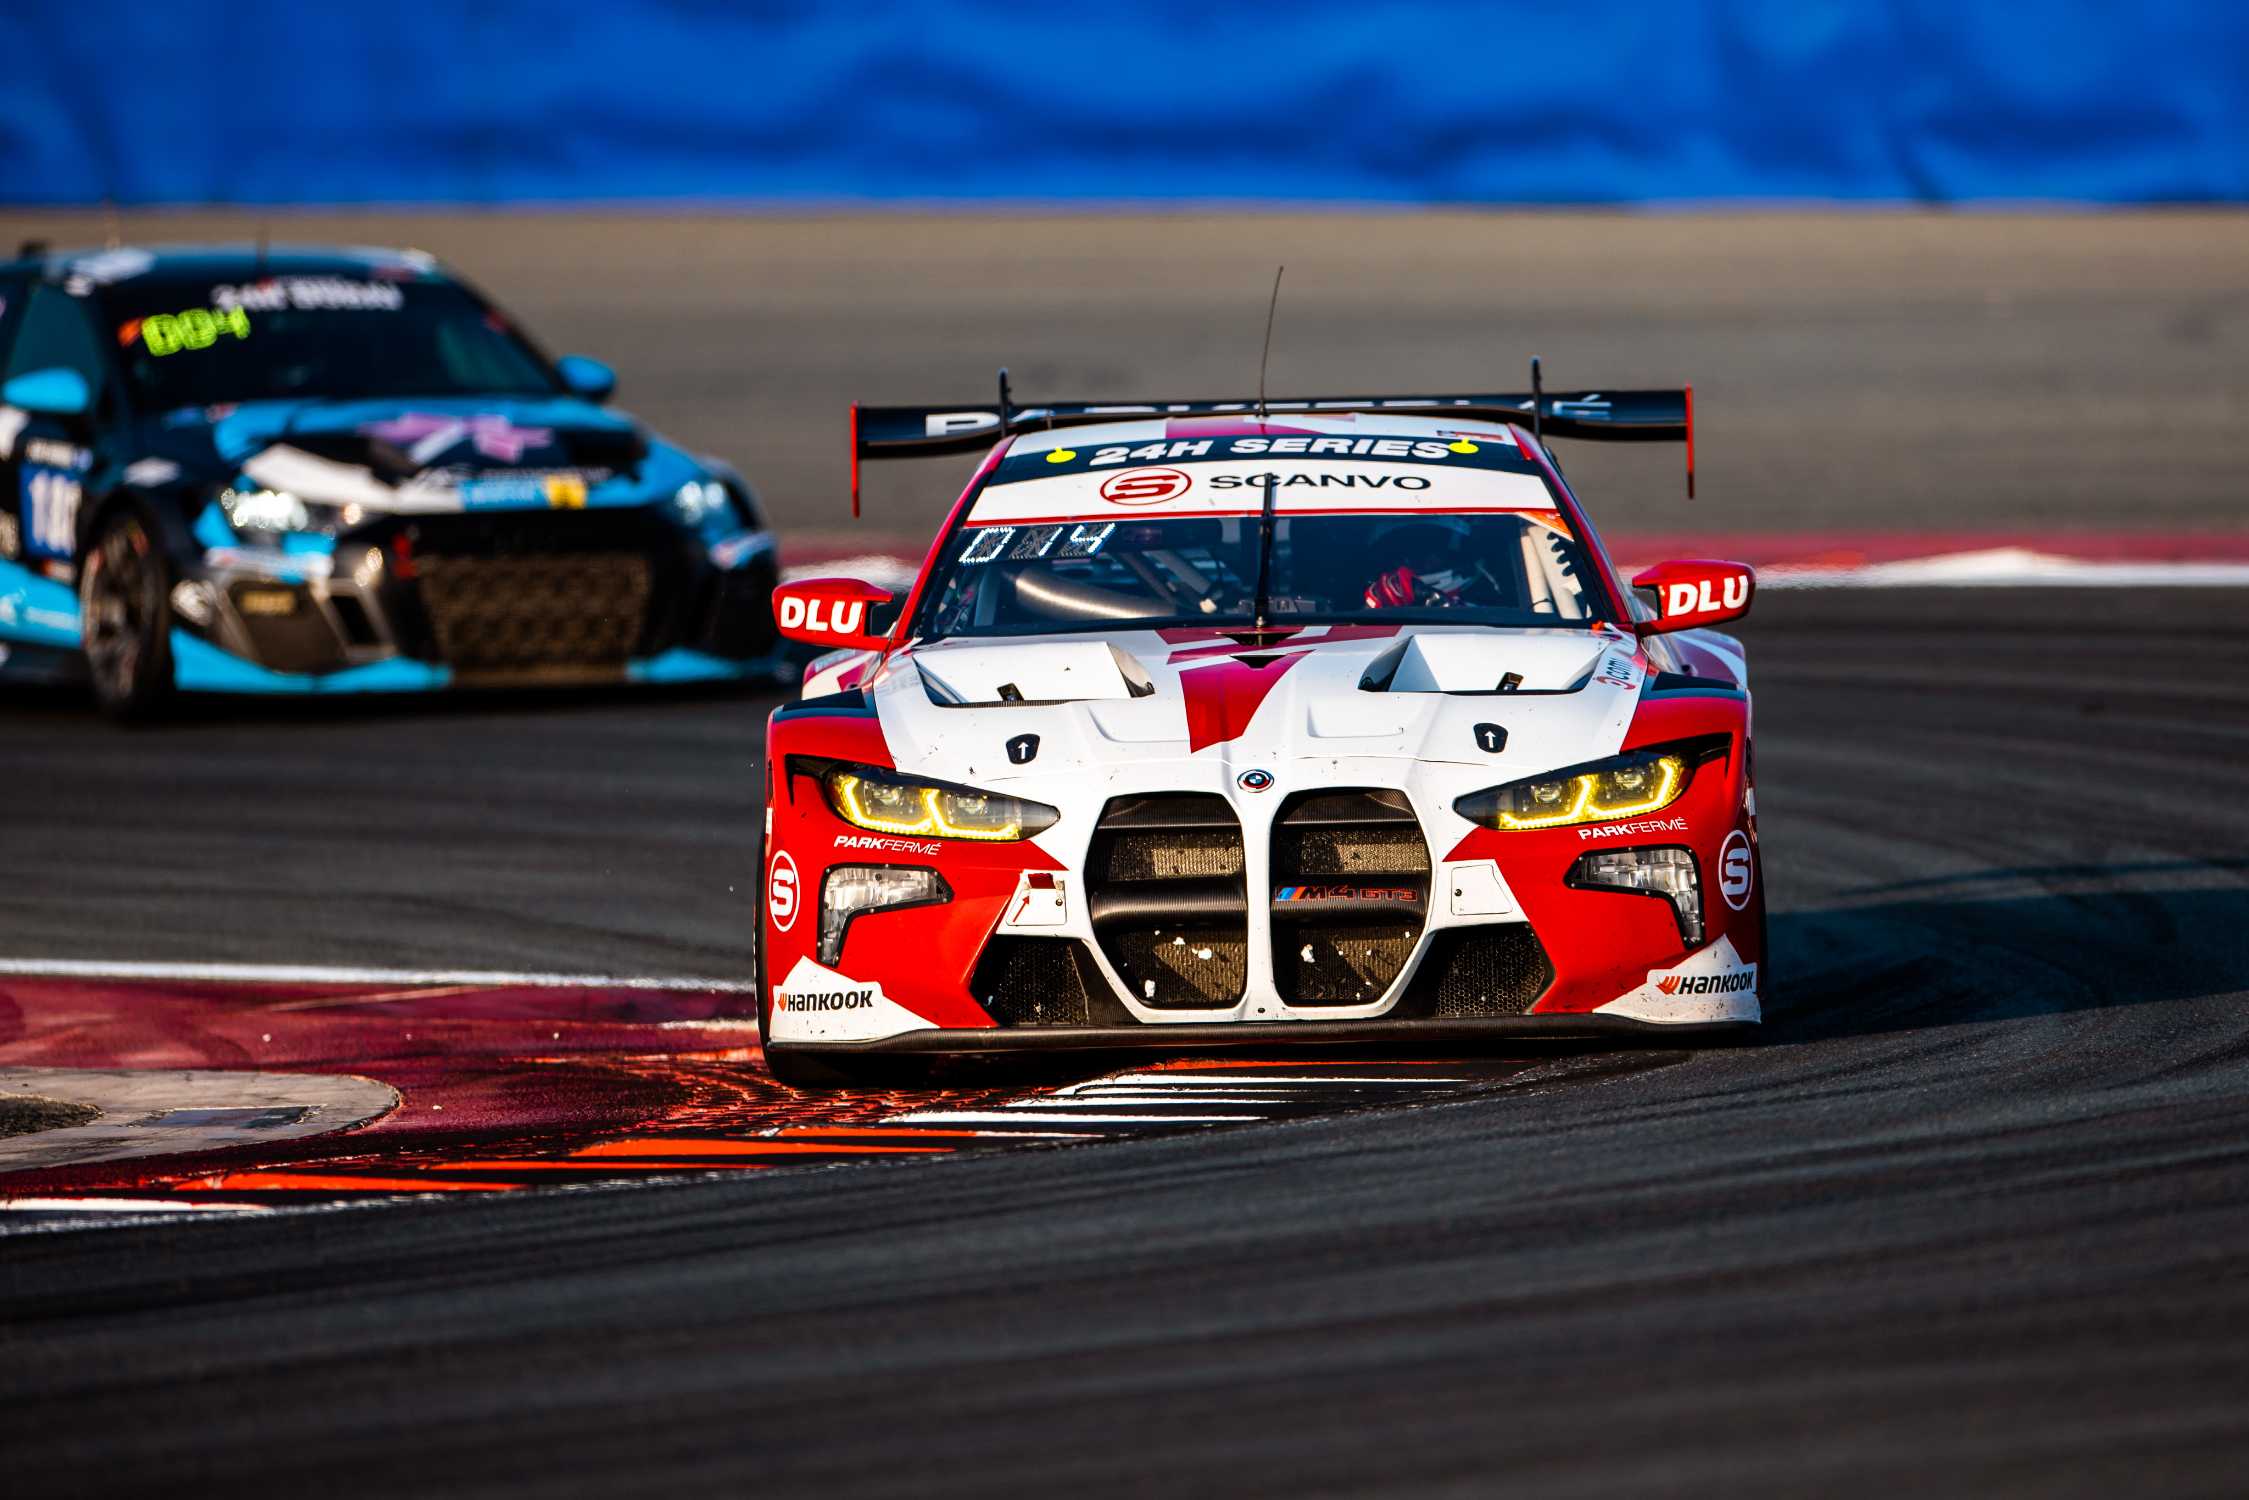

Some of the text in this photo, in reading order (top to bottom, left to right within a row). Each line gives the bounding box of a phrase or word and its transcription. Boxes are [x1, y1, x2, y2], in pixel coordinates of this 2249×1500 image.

[1089, 438, 1451, 466] 24H SERIES
[1209, 473, 1432, 491] SCANVO
[958, 522, 1117, 564] 014
[1667, 575, 1749, 617] DLU
[780, 596, 863, 634] DLU
[1577, 816, 1689, 841] PARKFERMÉ
[833, 834, 942, 856] PARKFERMÉ
[1360, 888, 1417, 901] GT3
